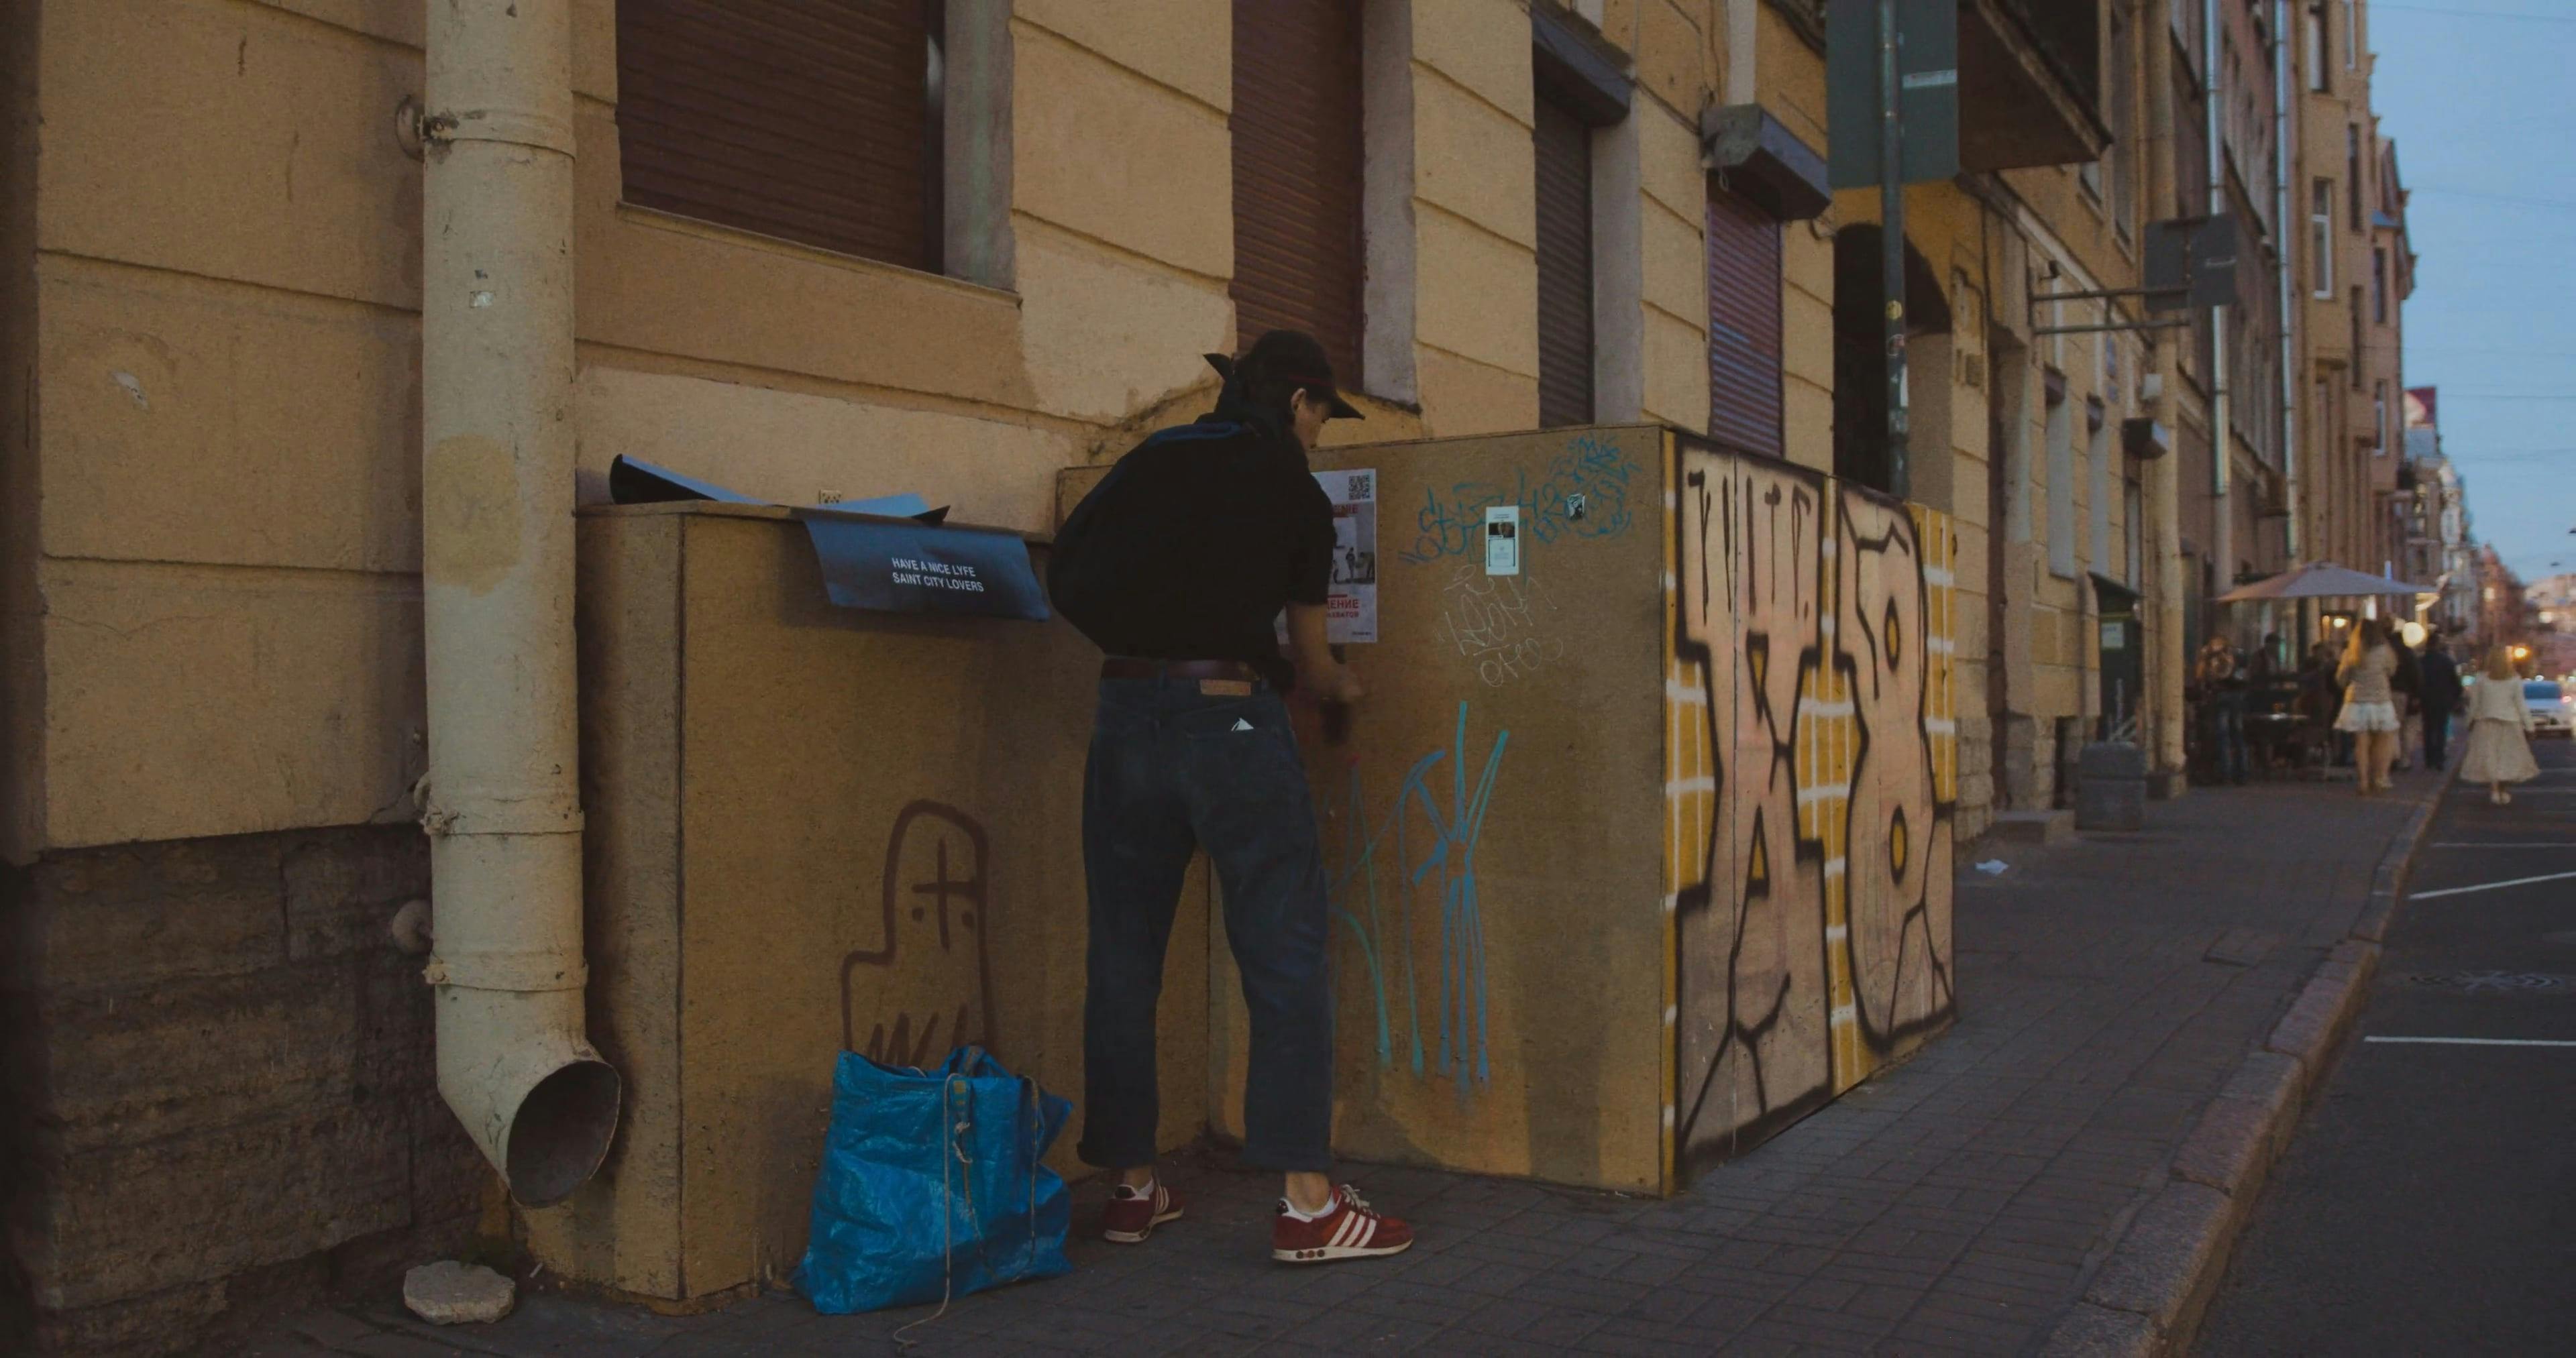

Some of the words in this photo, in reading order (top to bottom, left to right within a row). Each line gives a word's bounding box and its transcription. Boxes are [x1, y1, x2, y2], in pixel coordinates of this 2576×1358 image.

[891, 557, 919, 571] HAVE
[920, 561, 928, 571] A
[928, 561, 951, 575] NICE
[952, 565, 977, 577] LYFE
[892, 571, 922, 585] SAINT
[924, 575, 945, 588] CITY
[946, 579, 985, 592] LOVERS
